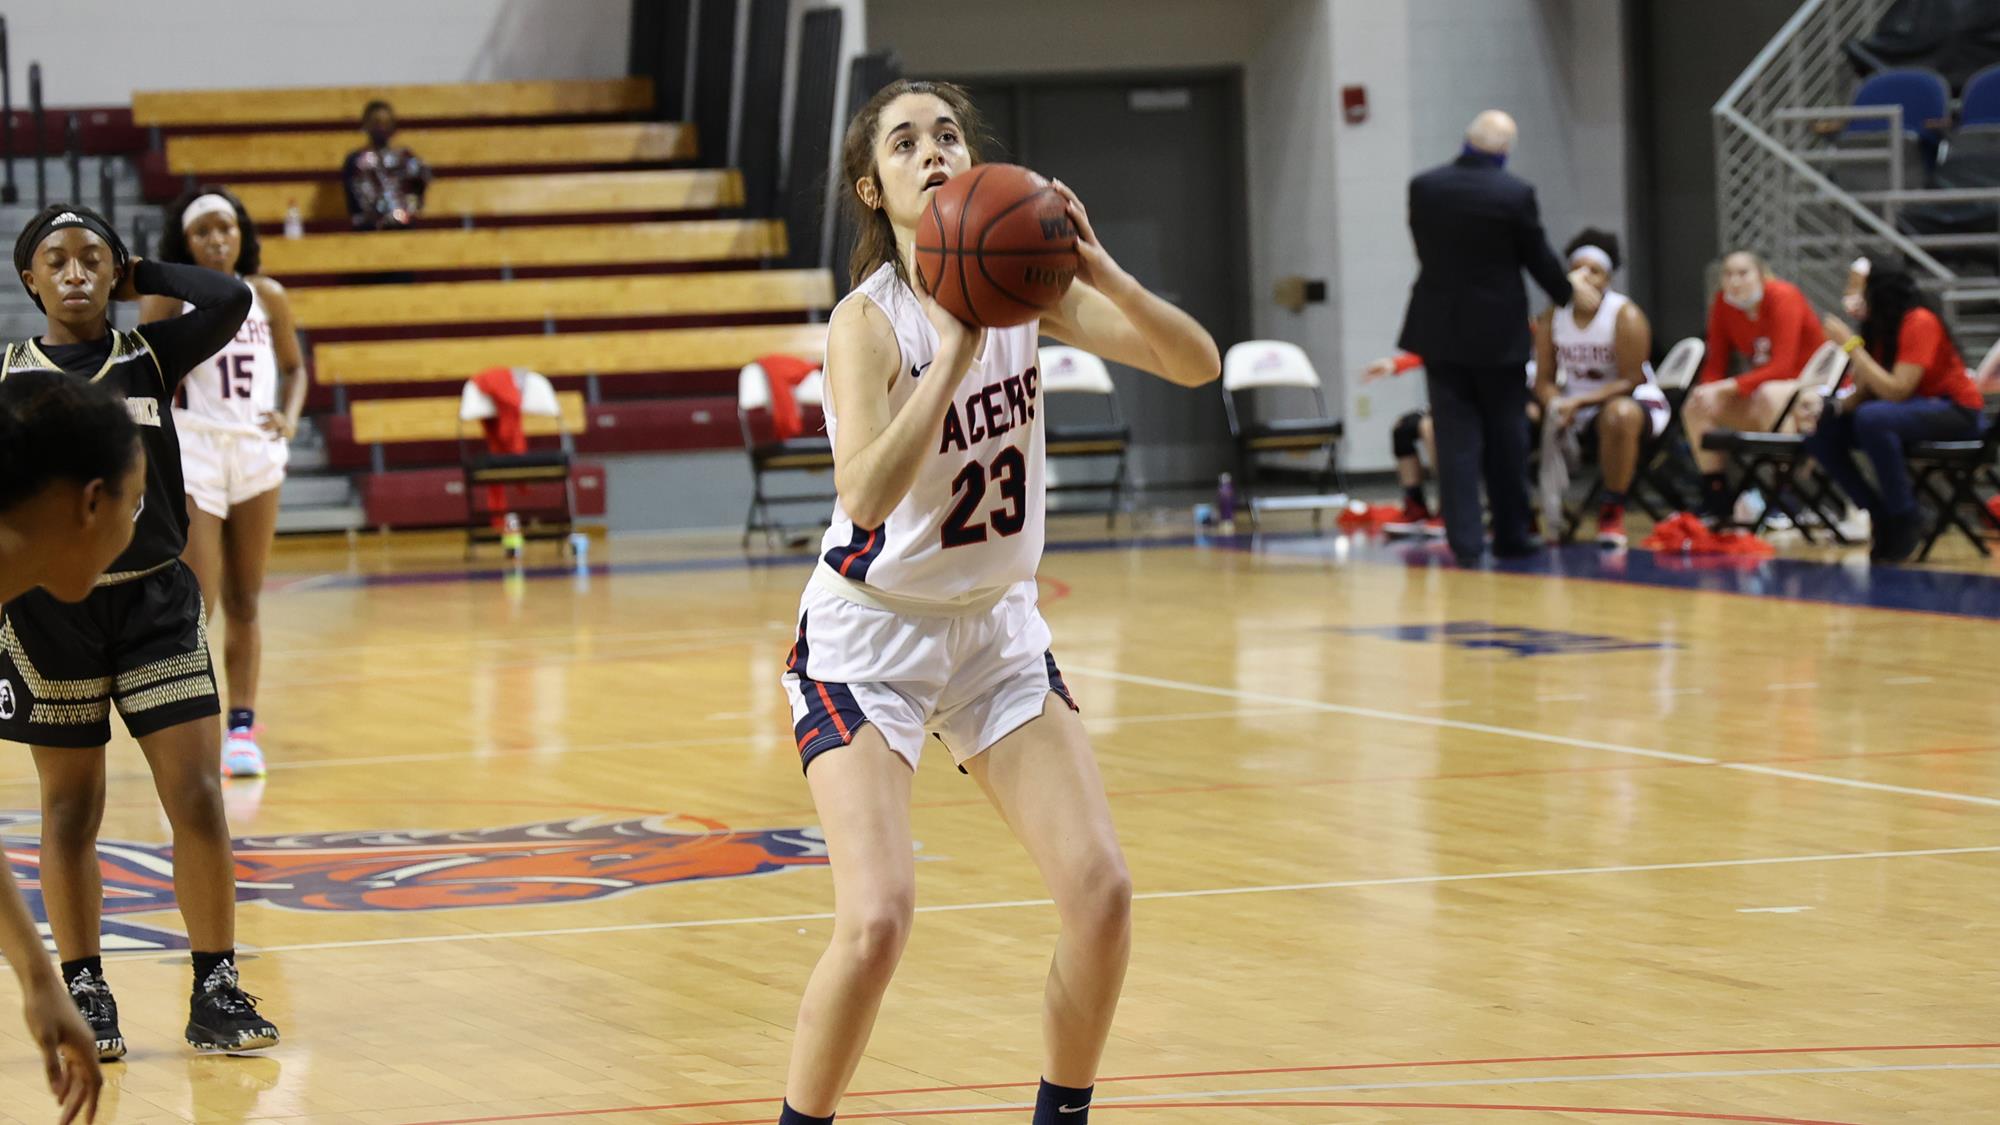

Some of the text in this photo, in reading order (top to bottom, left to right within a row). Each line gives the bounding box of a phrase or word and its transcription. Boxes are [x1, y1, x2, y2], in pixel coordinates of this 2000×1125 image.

[215, 354, 255, 399] 15
[939, 366, 1038, 455] ACERS
[940, 445, 1027, 549] 23
